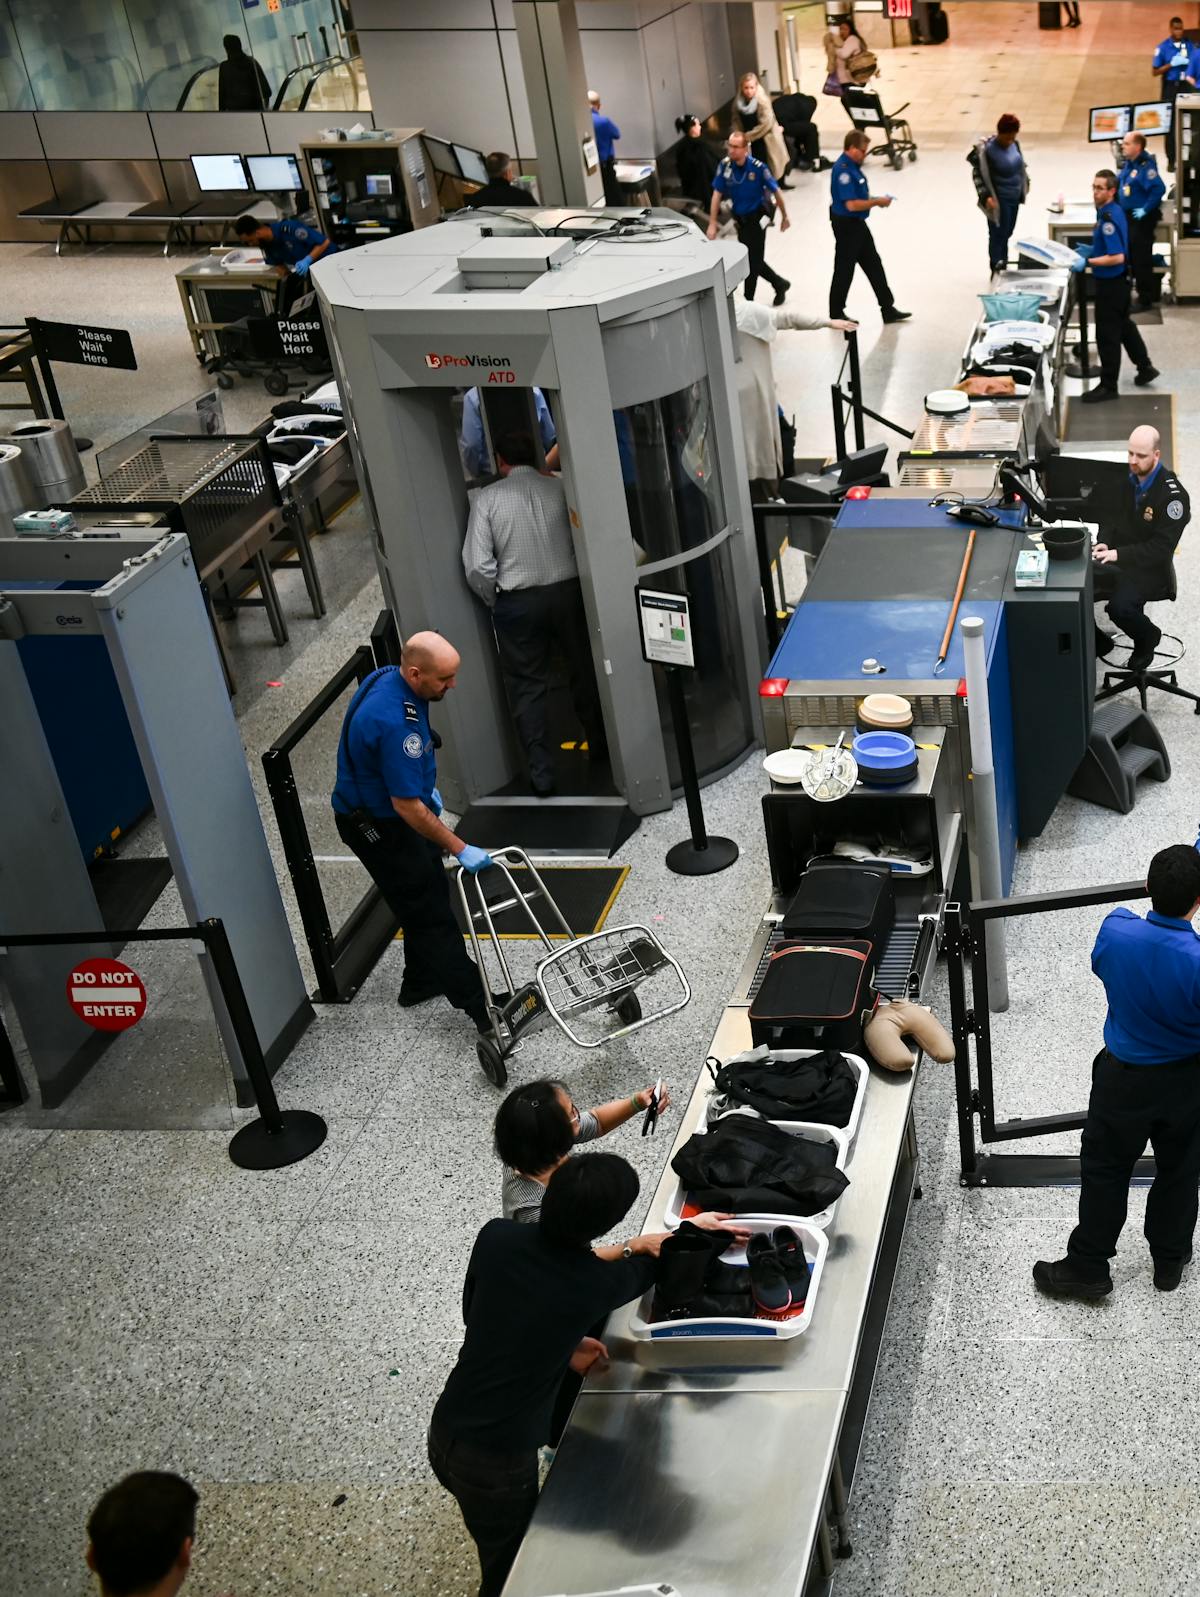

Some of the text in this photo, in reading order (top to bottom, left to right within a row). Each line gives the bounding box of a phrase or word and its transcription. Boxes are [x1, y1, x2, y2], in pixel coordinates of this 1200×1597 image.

[277, 320, 320, 332] Please
[280, 332, 309, 343] Wait
[79, 340, 105, 353] Wait
[283, 344, 314, 355] Here
[82, 351, 108, 365] Here
[442, 354, 511, 368] ProVision
[487, 371, 515, 384] ATD
[72, 972, 134, 984] DO NOT
[82, 1005, 136, 1017] ENTER
